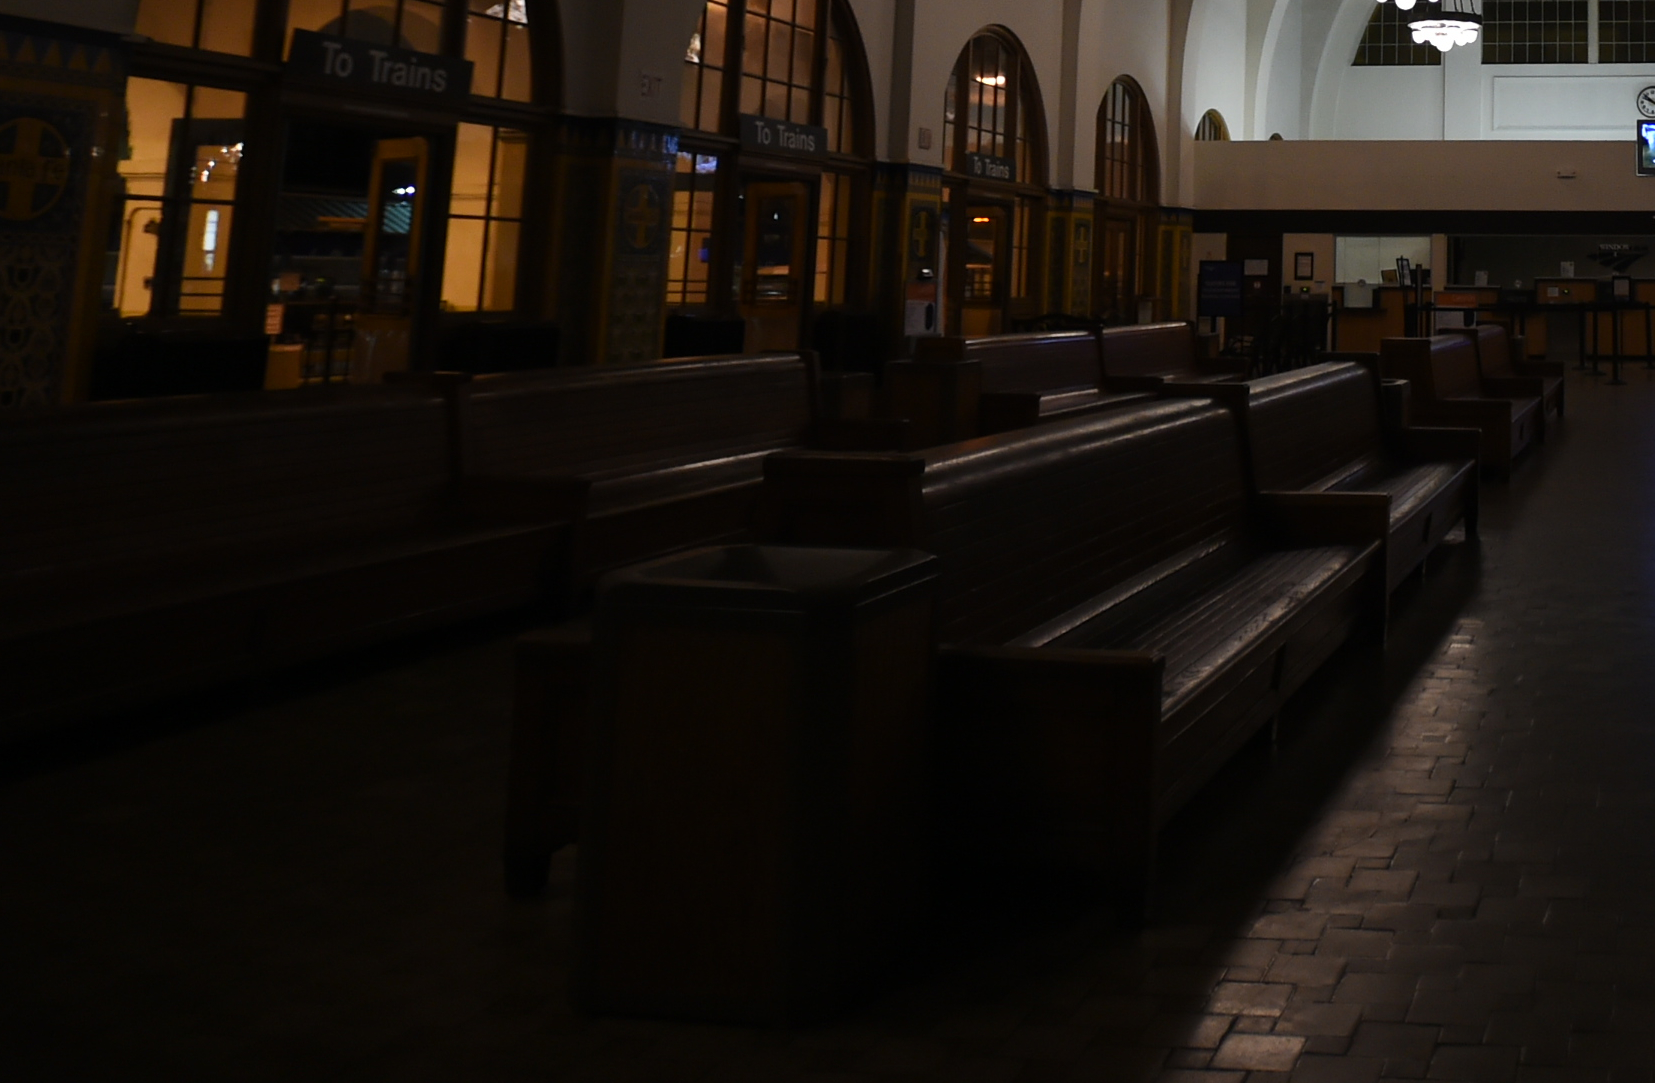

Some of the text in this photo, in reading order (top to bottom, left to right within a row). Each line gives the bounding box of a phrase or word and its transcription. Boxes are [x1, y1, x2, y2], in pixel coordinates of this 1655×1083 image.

[321, 41, 448, 92] To Trains
[755, 121, 816, 152] To Trains
[973, 156, 1010, 179] To Trains
